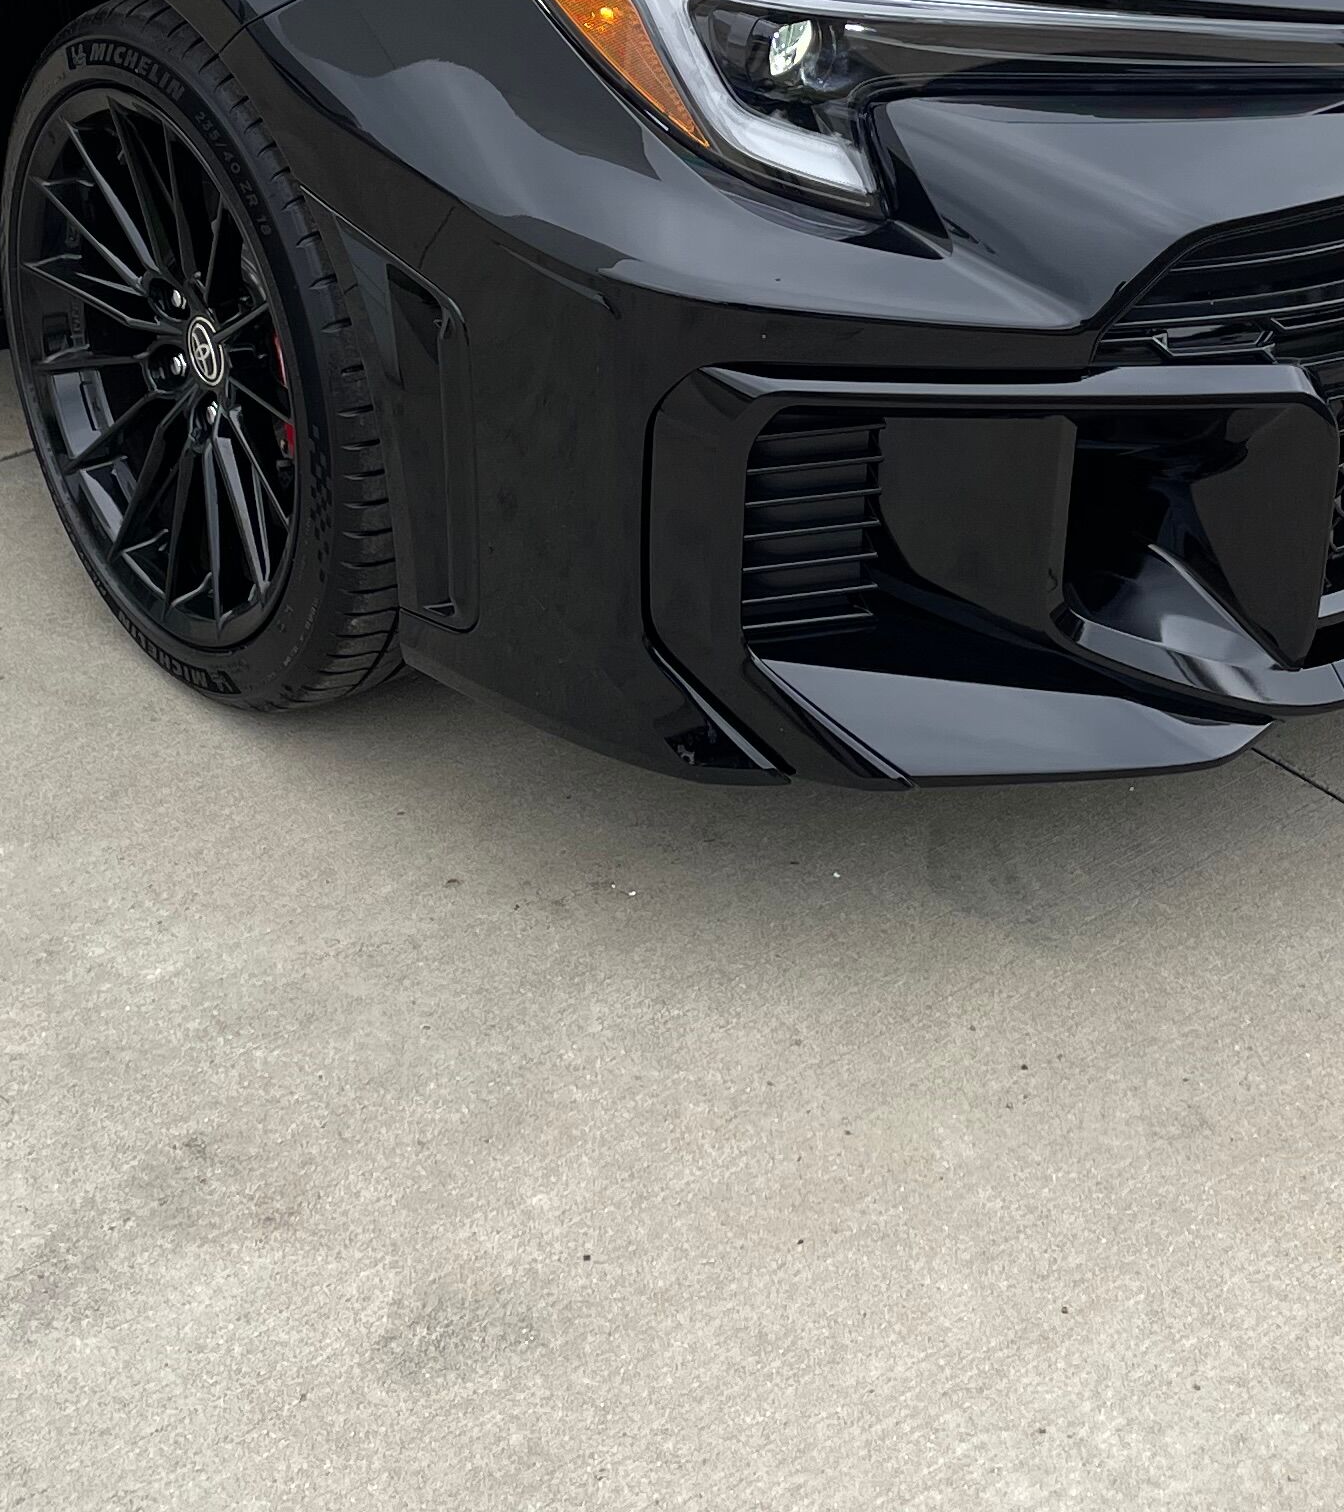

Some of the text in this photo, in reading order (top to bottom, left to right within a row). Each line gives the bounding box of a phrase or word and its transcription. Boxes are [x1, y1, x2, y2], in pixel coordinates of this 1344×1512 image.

[89, 42, 186, 102] MICHELIN
[194, 110, 242, 174] 235/40
[118, 610, 208, 687] MICHELIN
